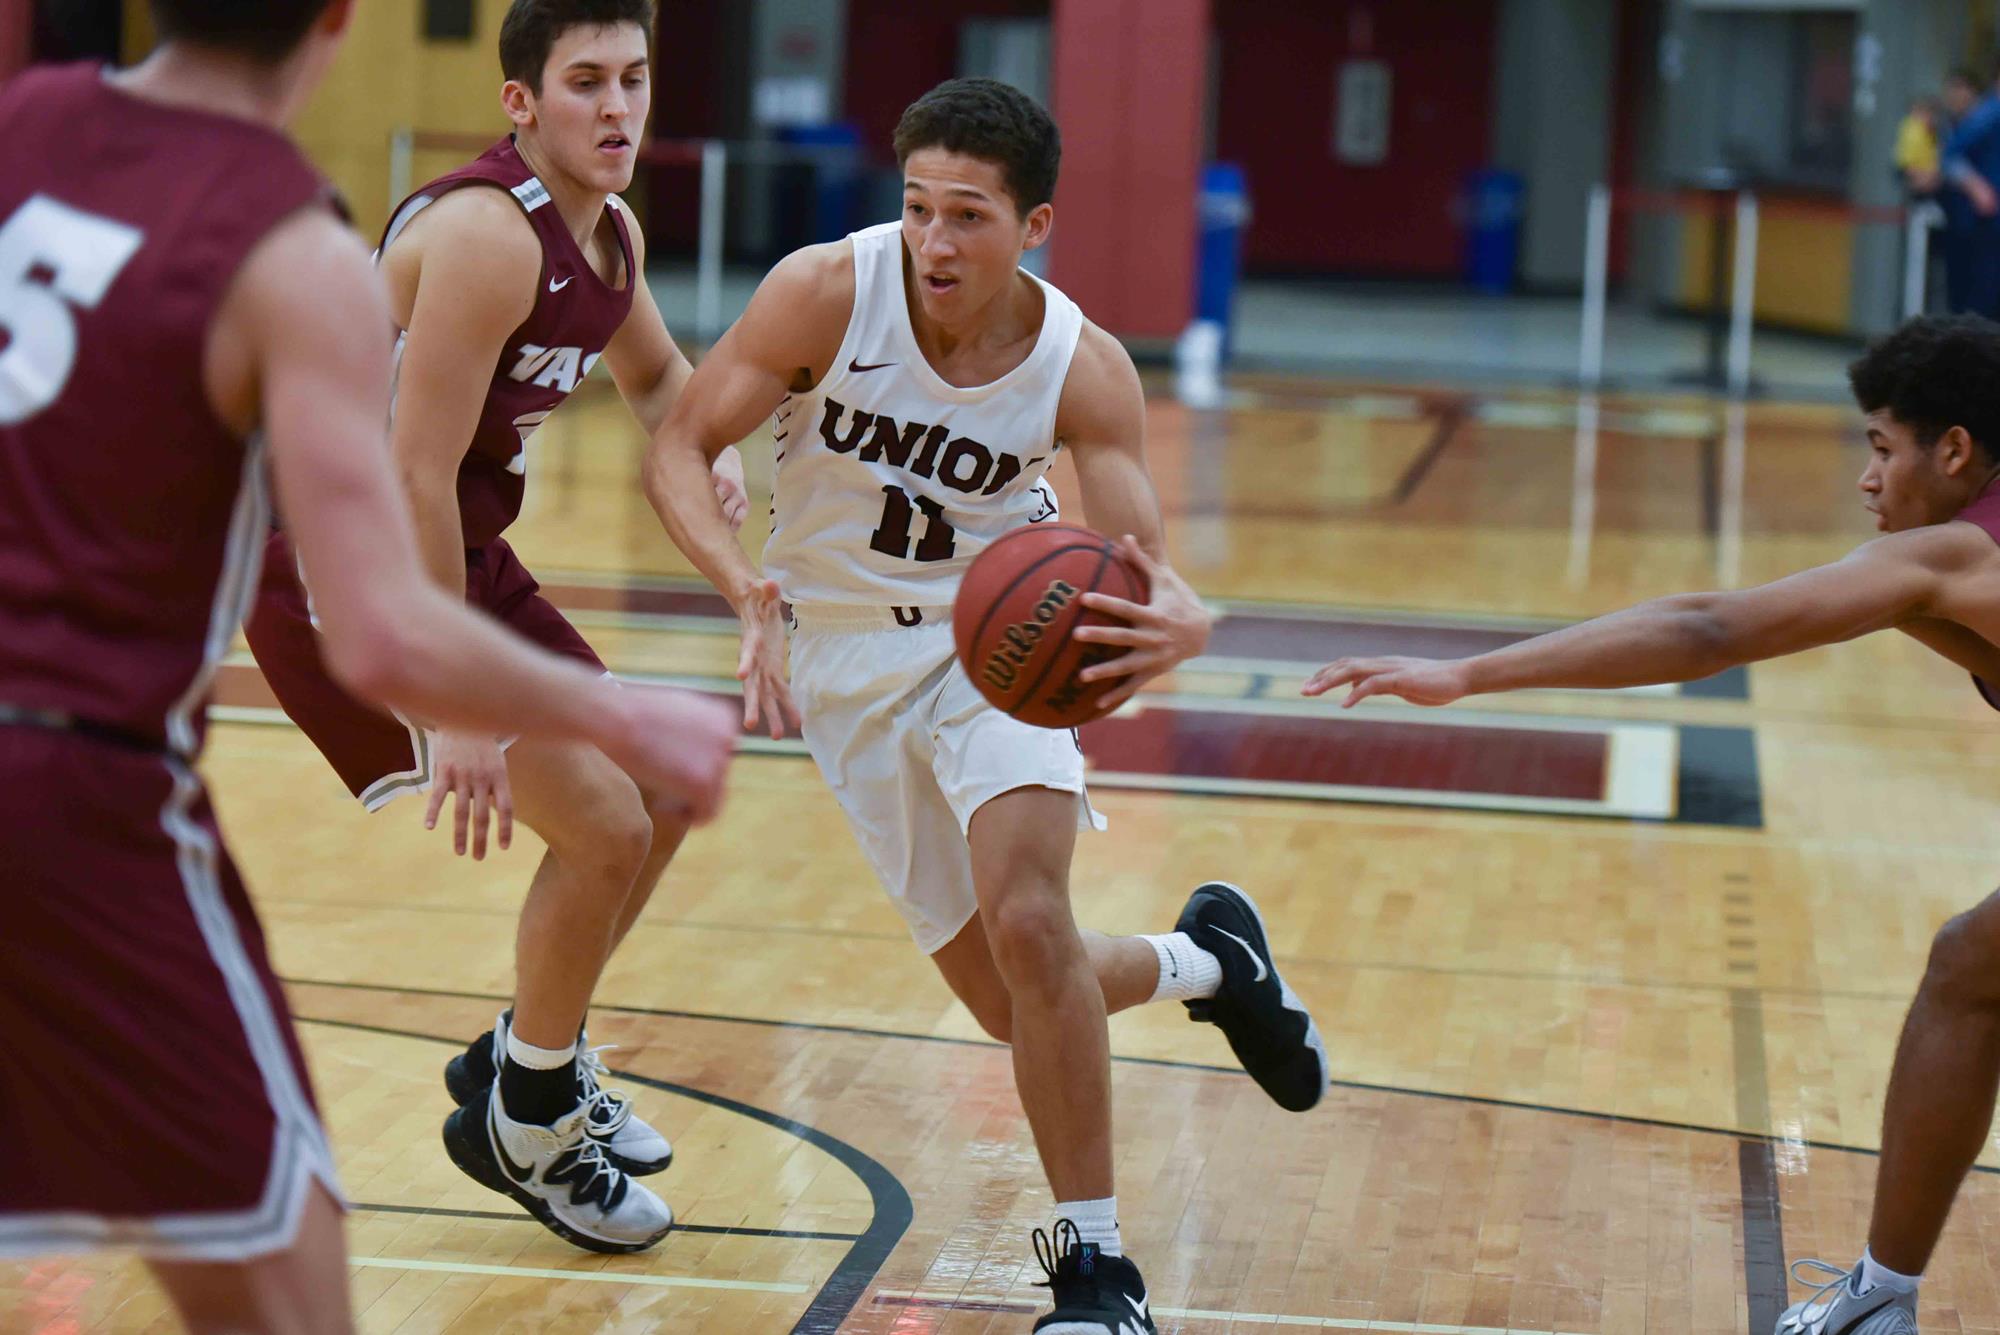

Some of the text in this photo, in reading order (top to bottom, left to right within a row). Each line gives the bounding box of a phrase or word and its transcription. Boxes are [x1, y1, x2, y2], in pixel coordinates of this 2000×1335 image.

[0, 192, 145, 426] 5
[869, 484, 956, 562] 11
[983, 580, 1080, 692] Wilson
